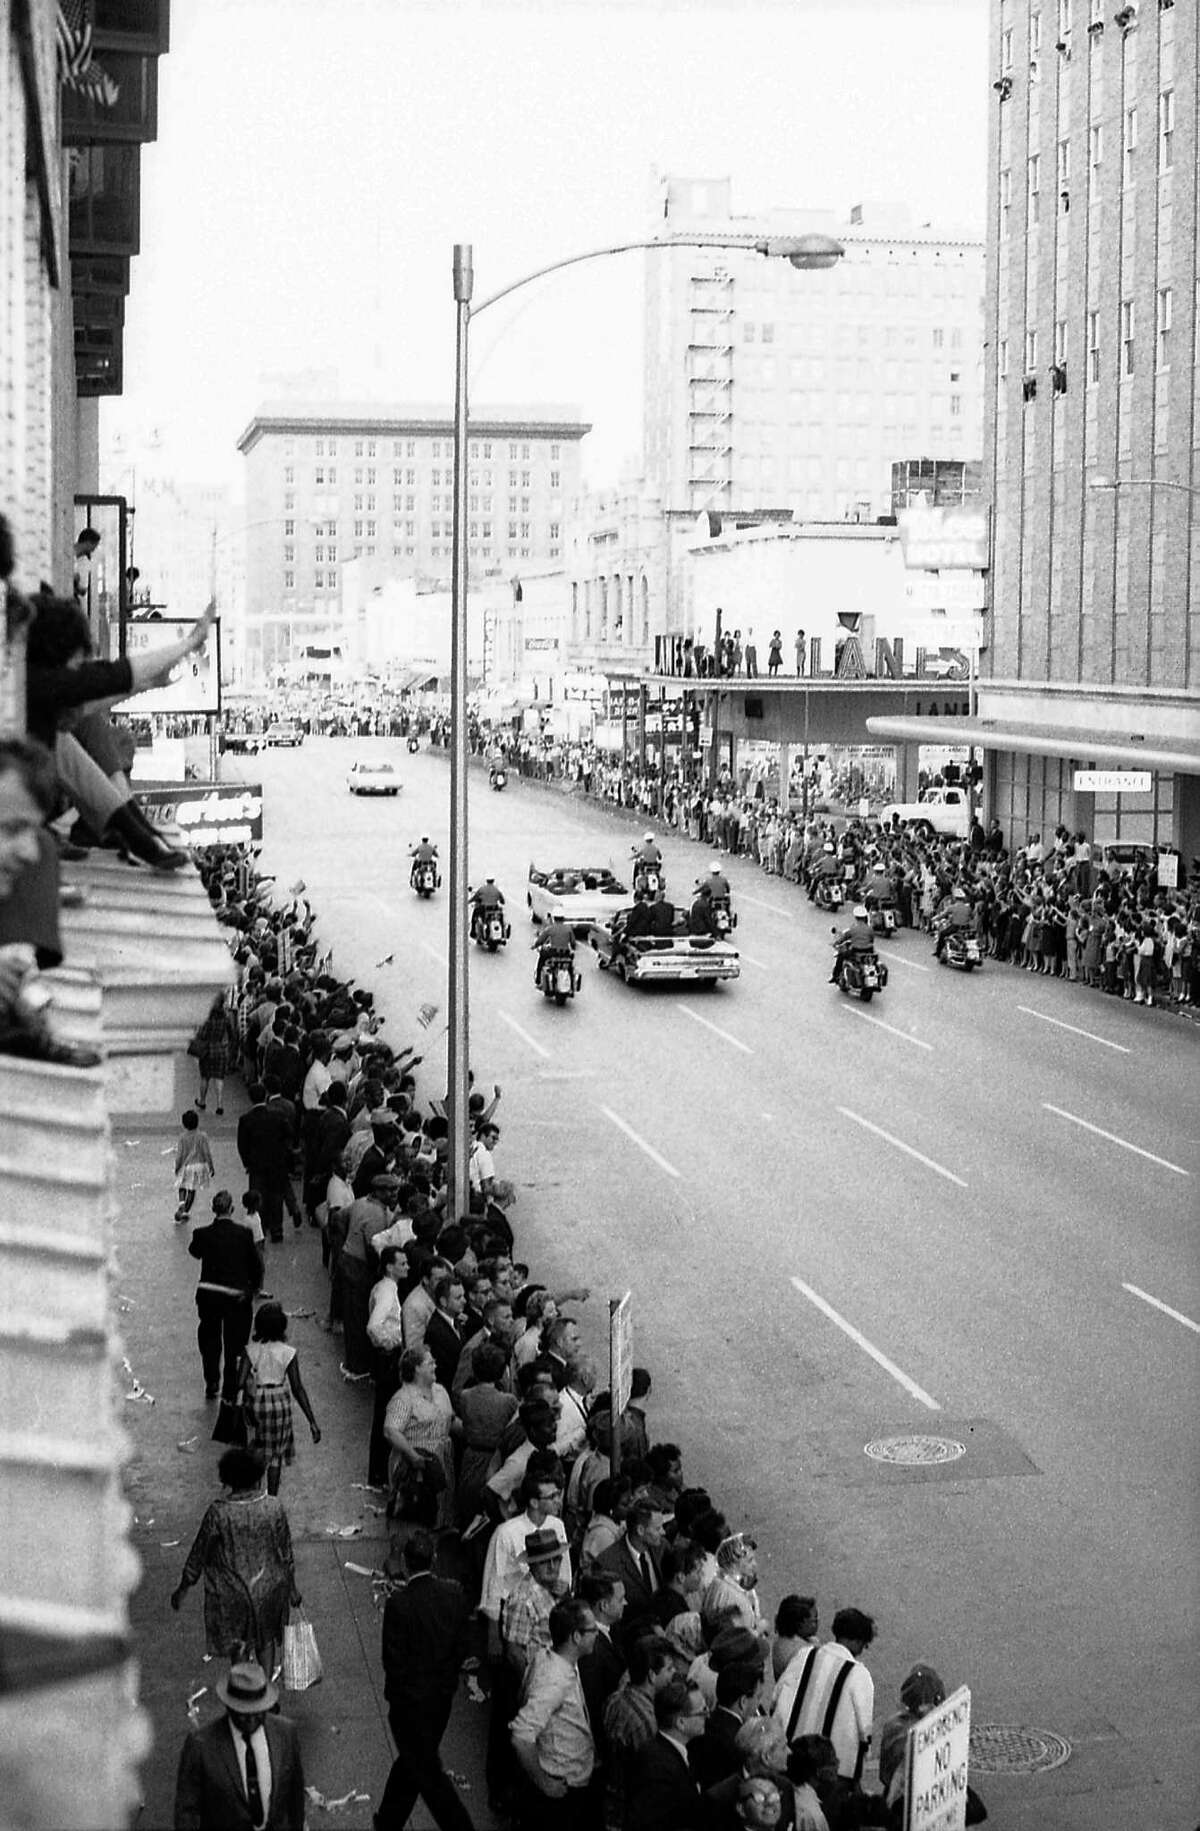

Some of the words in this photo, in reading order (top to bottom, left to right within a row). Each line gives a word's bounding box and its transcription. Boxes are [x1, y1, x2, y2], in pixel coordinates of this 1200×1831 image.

[811, 637, 970, 680] LANES
[935, 1741, 951, 1776] NO
[916, 1762, 967, 1814] PARKING
